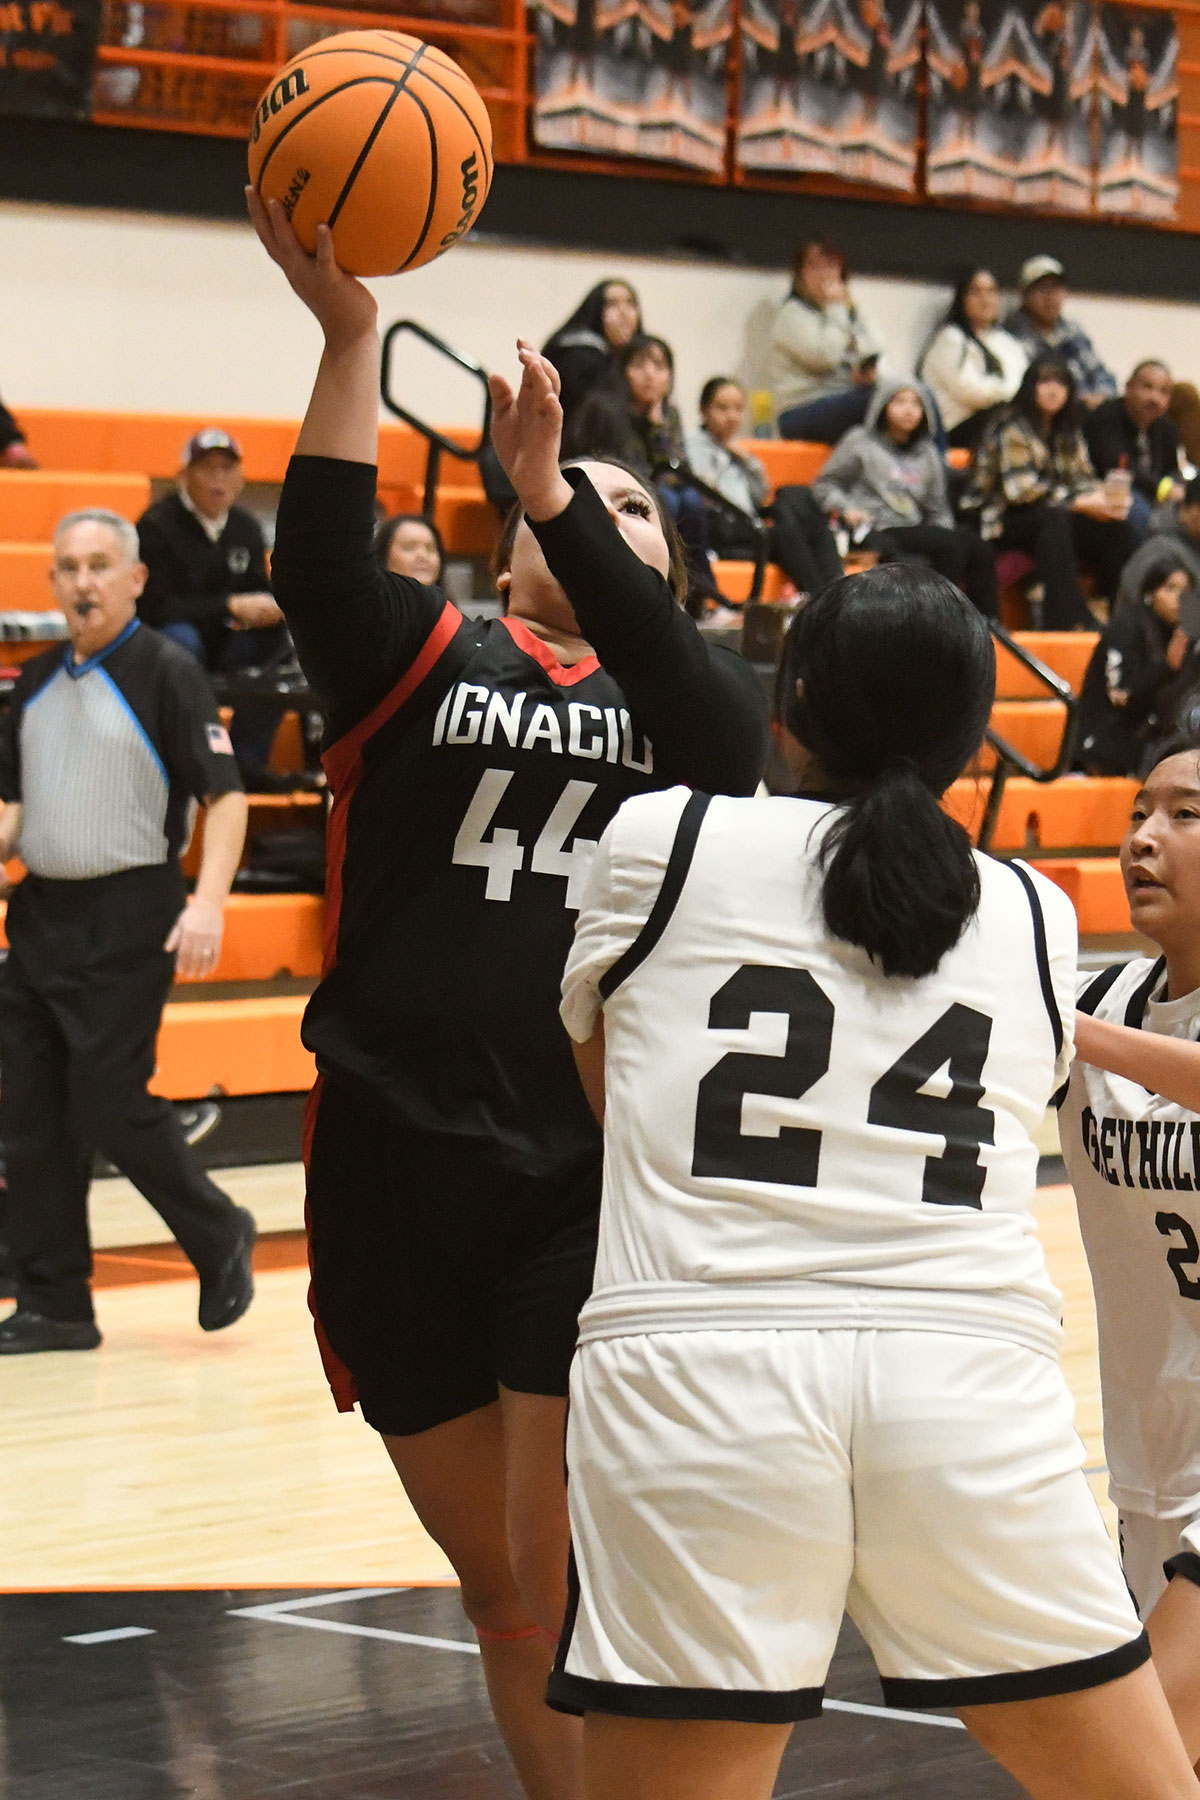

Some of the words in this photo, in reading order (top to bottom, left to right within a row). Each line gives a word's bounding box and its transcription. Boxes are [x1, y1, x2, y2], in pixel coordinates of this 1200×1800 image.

[432, 682, 653, 774] IGNACIO
[452, 768, 598, 910] 44
[691, 964, 996, 1210] 24
[1082, 1106, 1200, 1191] GEYHIL
[1155, 1211, 1200, 1300] 2
